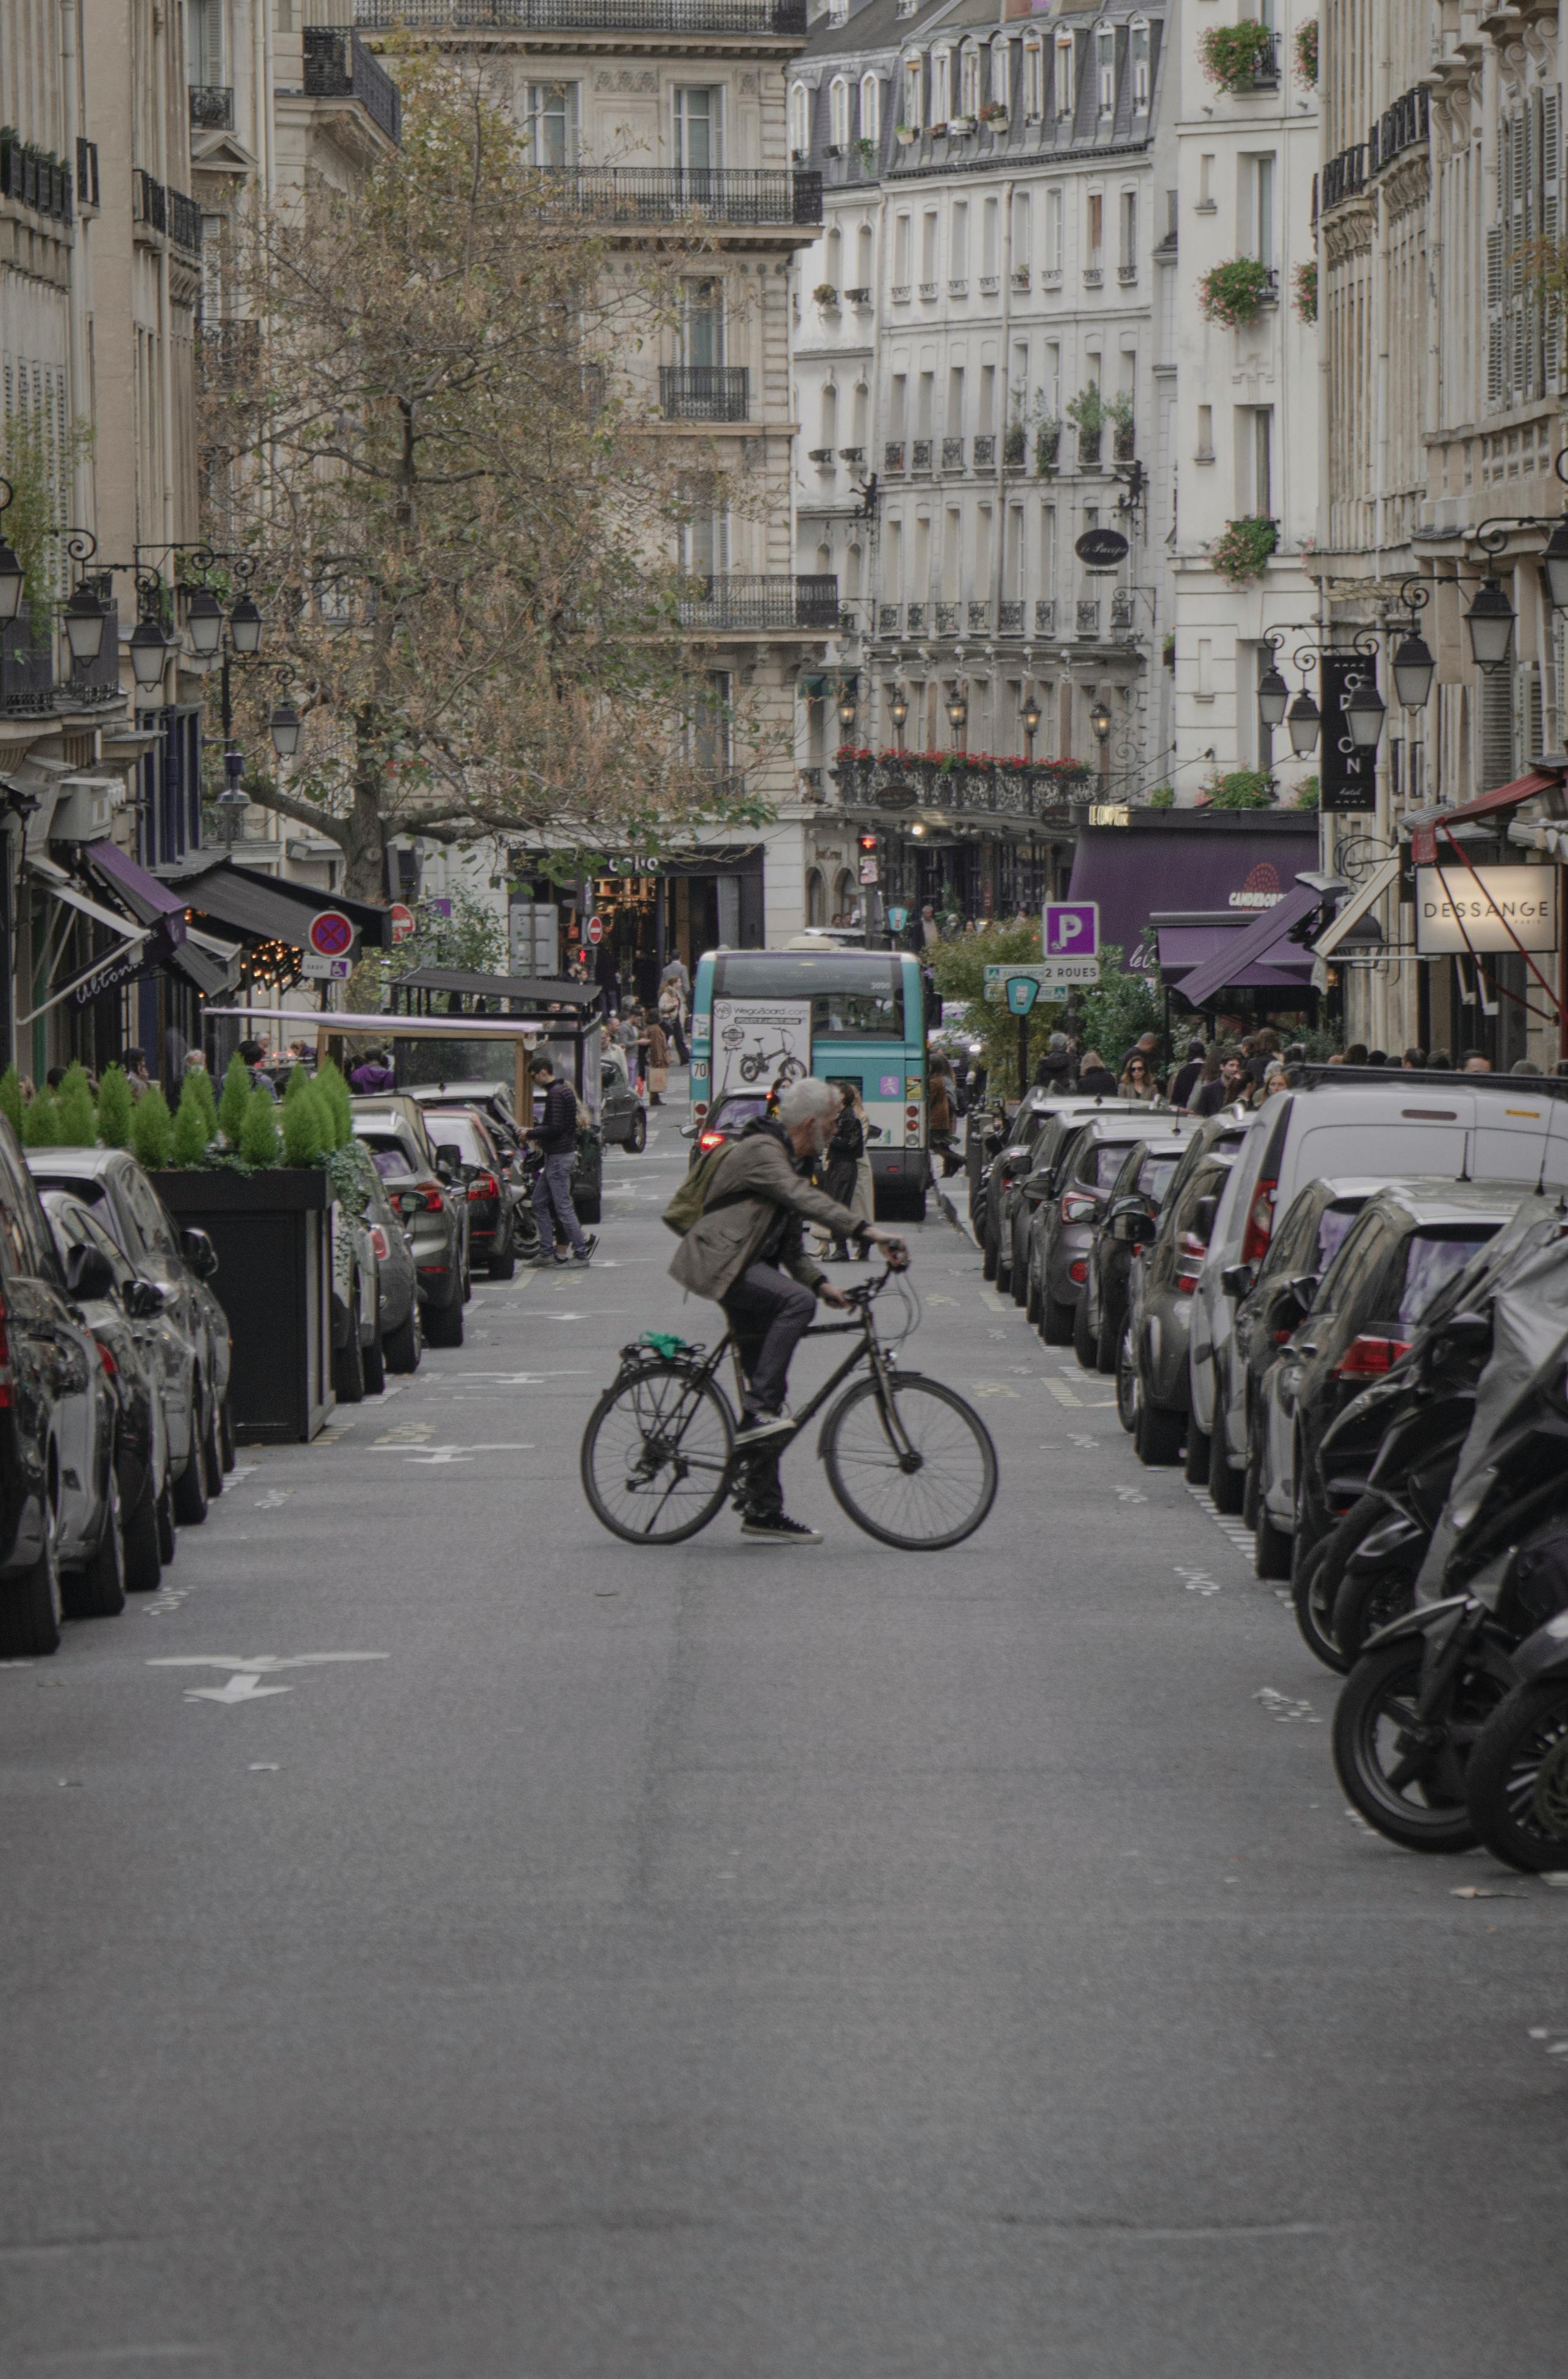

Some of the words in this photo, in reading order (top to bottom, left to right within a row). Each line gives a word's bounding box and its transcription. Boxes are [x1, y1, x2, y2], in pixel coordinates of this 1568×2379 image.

[1424, 901, 1548, 918] DESSANGE
[1059, 915, 1082, 948] P
[1045, 968, 1052, 978] 2
[1057, 967, 1097, 978] ROUES
[694, 1063, 707, 1077] 70
